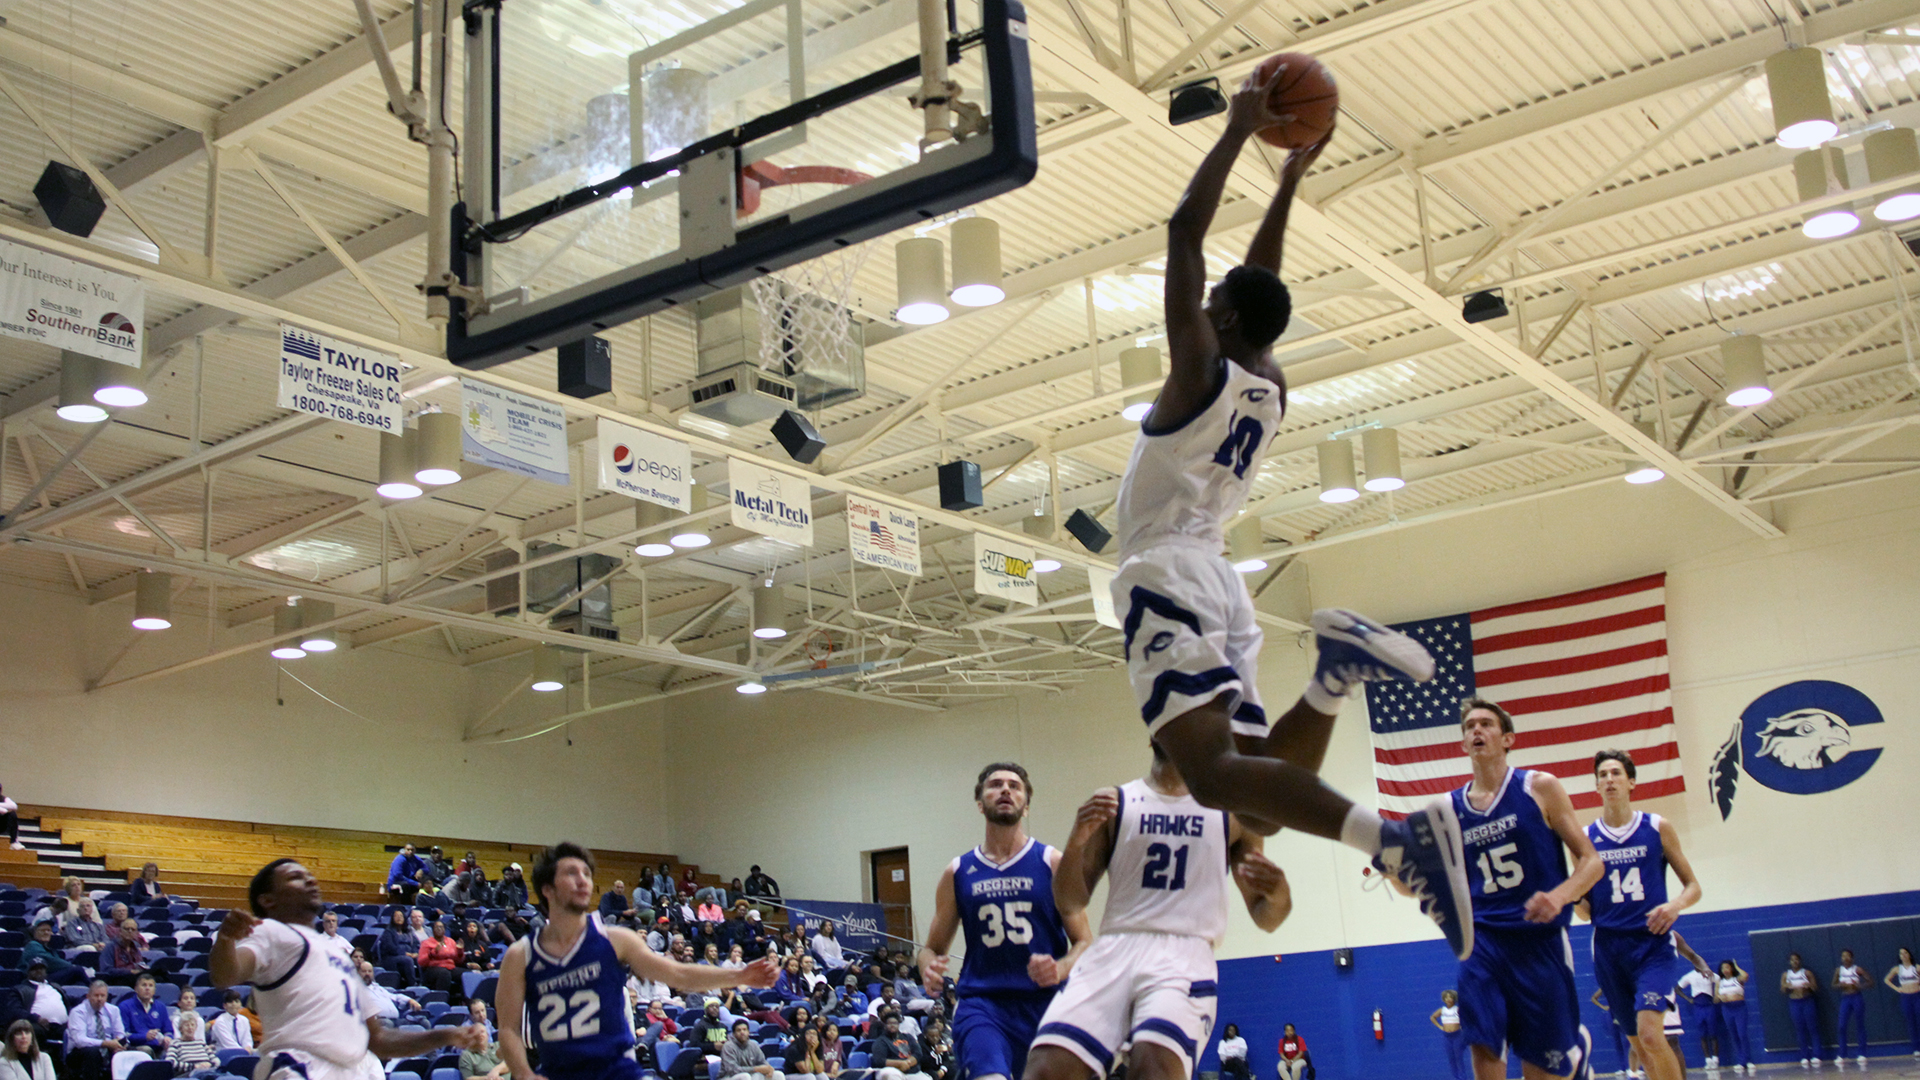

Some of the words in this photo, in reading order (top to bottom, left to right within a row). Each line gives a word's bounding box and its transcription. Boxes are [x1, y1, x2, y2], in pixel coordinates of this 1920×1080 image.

[0, 256, 19, 274] ur
[23, 262, 73, 289] Interest
[77, 279, 88, 293] is
[91, 281, 118, 303] You.
[40, 298, 62, 311] Since
[65, 305, 82, 316] 1901
[27, 327, 47, 338] FDIC
[281, 357, 313, 382] Taylor
[316, 367, 354, 392] Freezer
[357, 378, 384, 401] Sales
[323, 347, 400, 383] TAYLOR
[306, 382, 365, 408] Chesapeake,
[367, 398, 380, 410] Va
[292, 394, 392, 430] 1800-768-6945
[507, 408, 536, 423] MOBILE
[538, 417, 563, 431] CRISIS
[507, 416, 530, 427] TEAM
[637, 457, 682, 482] pepsi
[616, 478, 650, 496] McPherson
[735, 489, 774, 514] Metal
[776, 500, 809, 525] Tech
[866, 551, 903, 570] AMERICAN
[980, 549, 1034, 580] SUBWAY
[1139, 813, 1205, 838] HAWKS
[1463, 813, 1518, 846] REGENT
[1141, 842, 1190, 891] 21
[1476, 841, 1525, 894] 15
[1598, 845, 1648, 862] REGENT
[972, 876, 1034, 896] REGENT
[1608, 866, 1646, 904] 14
[978, 900, 1034, 949] 35
[537, 989, 601, 1042] 22
